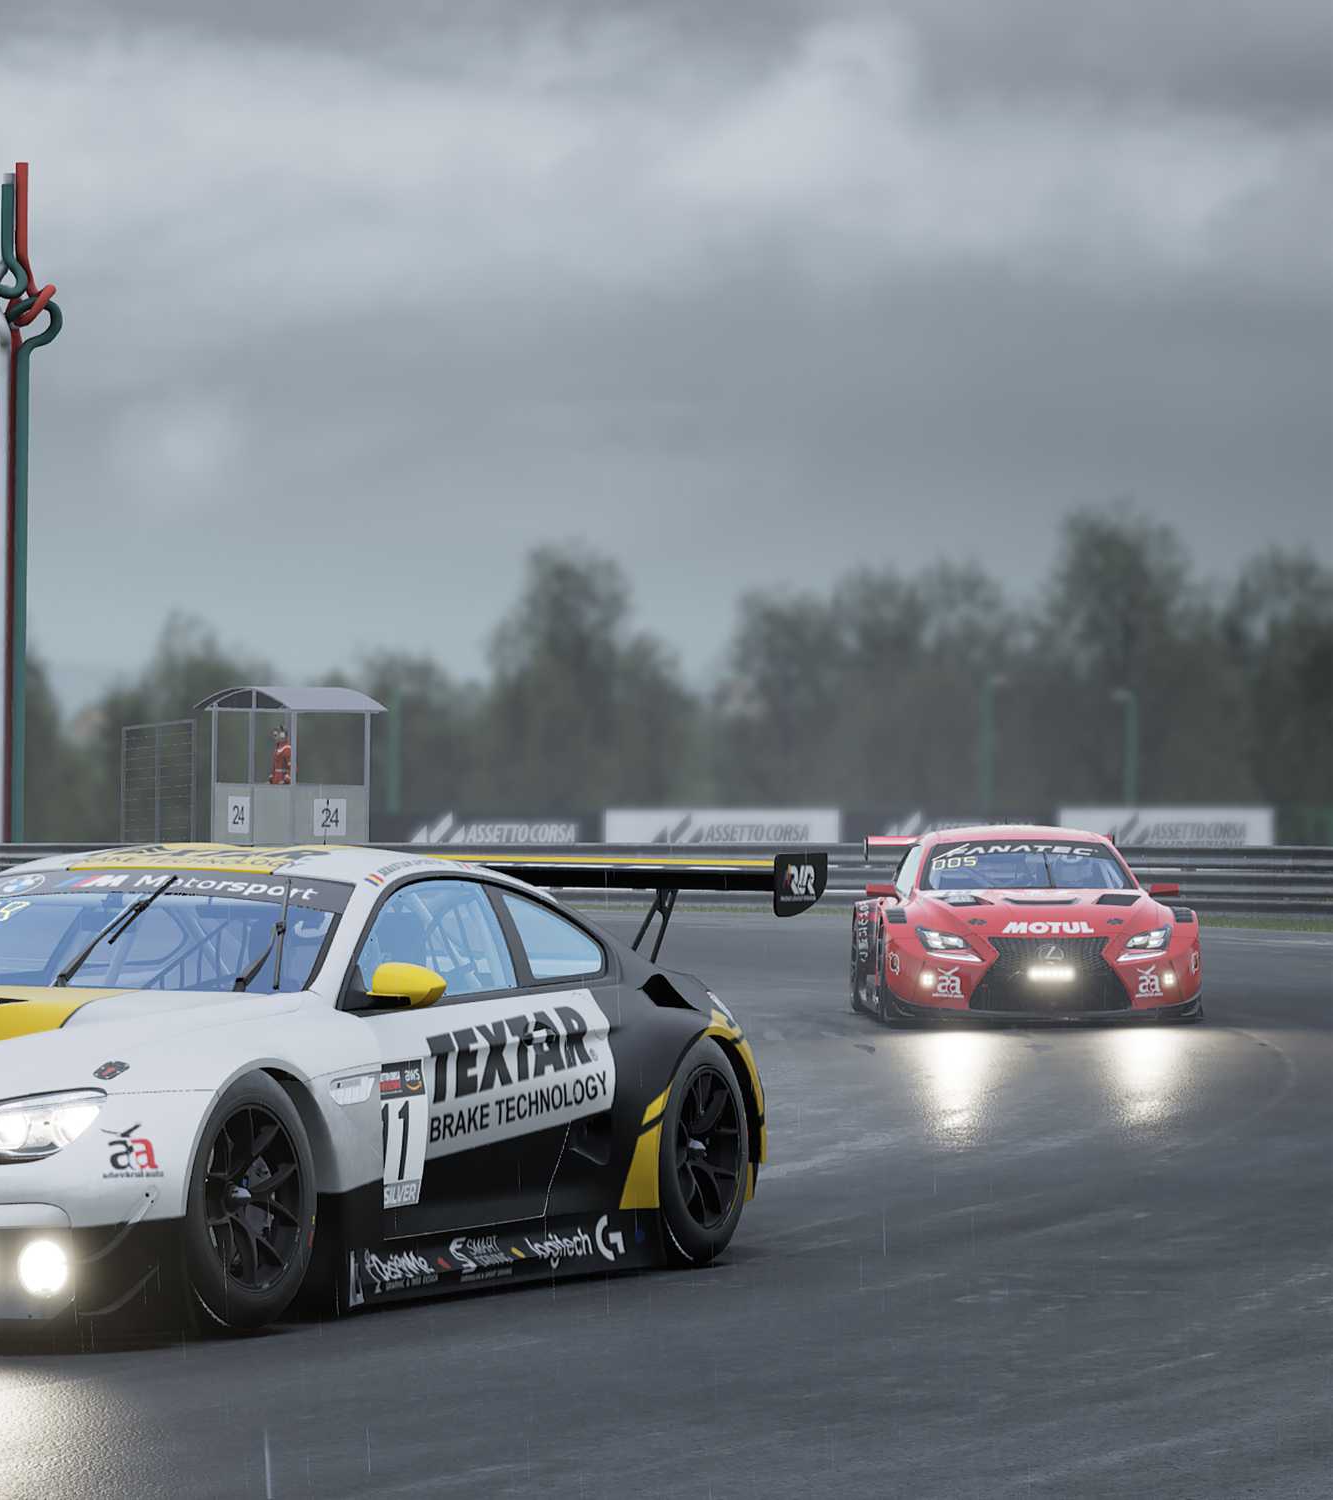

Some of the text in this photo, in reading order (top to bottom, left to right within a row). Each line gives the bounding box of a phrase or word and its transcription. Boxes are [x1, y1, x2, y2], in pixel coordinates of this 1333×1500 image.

[232, 805, 245, 825] 24
[321, 807, 340, 828] 24
[467, 823, 577, 843] ASSETTO CORSA
[704, 823, 810, 843] ASSETTO CORSA
[1151, 822, 1247, 841] ASSETTO CORSA
[932, 843, 1095, 861] FANATEC
[133, 873, 320, 901] Motorsport
[1002, 921, 1095, 935] MOTUL
[426, 1006, 592, 1105] TEXTAR
[429, 1070, 609, 1143] BRAKE TECHNOLOGY
[381, 1101, 410, 1181] 11
[383, 1183, 418, 1206] SILVER
[524, 1227, 594, 1270] logitech
